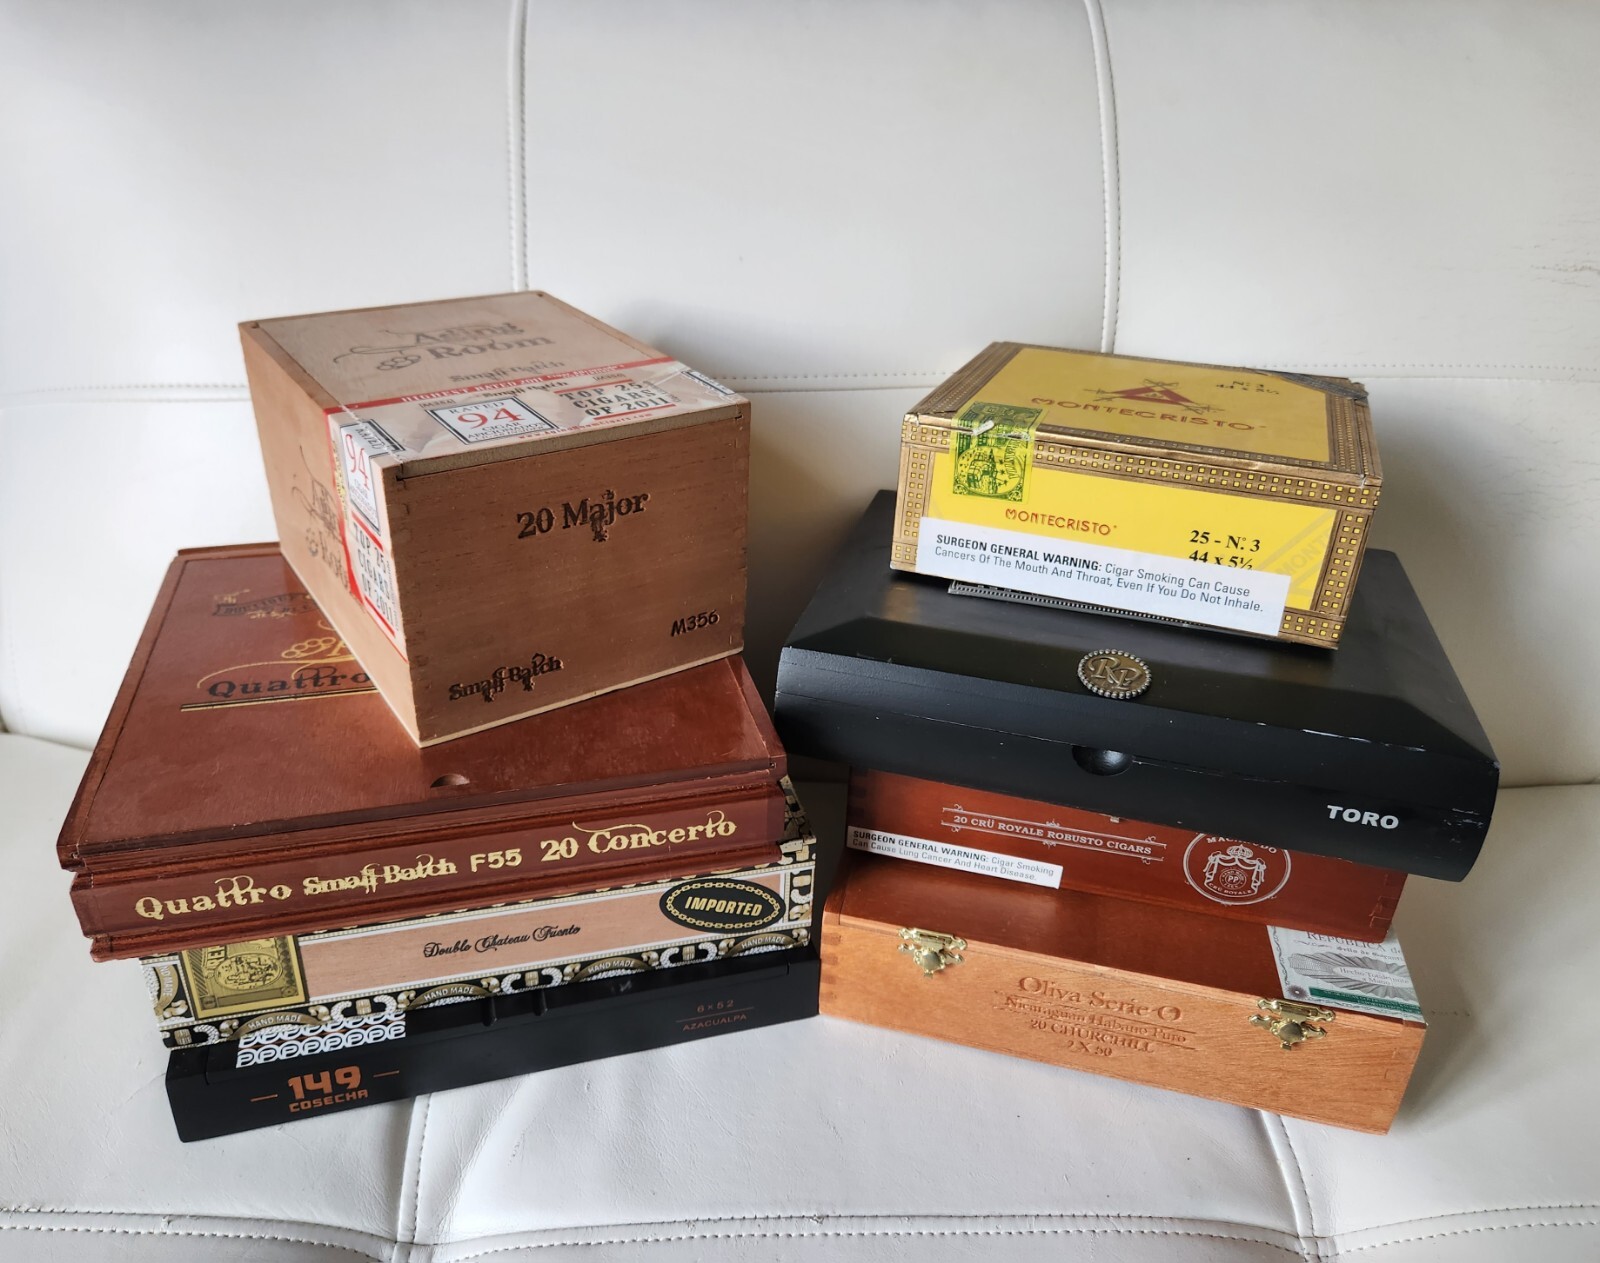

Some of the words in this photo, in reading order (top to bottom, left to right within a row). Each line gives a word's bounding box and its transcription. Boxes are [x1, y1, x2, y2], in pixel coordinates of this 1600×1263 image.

[425, 335, 556, 360] Room
[400, 388, 468, 402] HIGHEST
[475, 381, 516, 392] RATED
[520, 377, 543, 386] 2011
[559, 388, 605, 401] TOP
[615, 383, 644, 392] 25
[572, 388, 659, 409] CIGARS
[448, 402, 505, 414] RATED
[457, 407, 526, 429] 94
[584, 404, 617, 417] OF
[625, 397, 670, 411] 2011
[1030, 396, 1256, 432] MONTECRISTO
[482, 422, 522, 431] CIGAR
[345, 434, 371, 491] 94
[516, 508, 556, 539] 20
[561, 489, 651, 542] Major
[1005, 508, 1112, 537] MONTECRISTO
[1189, 529, 1211, 545] 25
[1250, 538, 1261, 553] 3
[936, 534, 988, 552] SURGEON
[990, 544, 1040, 561] GENERAL
[1043, 552, 1102, 572] WARNING:
[1105, 563, 1134, 578] Cigar
[1136, 568, 1185, 588] Smoking
[1188, 577, 1211, 590] Can
[1214, 581, 1250, 597] Cause
[935, 546, 976, 563] Cancers
[979, 553, 991, 564] Of
[993, 556, 1012, 568] The
[1015, 560, 1049, 575] Mouth
[1051, 566, 1073, 579] And
[1076, 571, 1113, 588] Throat,
[1117, 577, 1143, 592] Even
[1147, 581, 1157, 593] If
[1158, 584, 1178, 598] You
[1180, 588, 1197, 601] Do
[1200, 592, 1221, 605] Not
[1224, 596, 1264, 613] Inhale.
[670, 610, 720, 637] M356
[207, 666, 370, 699] Quattro
[1327, 804, 1399, 830] TORO
[953, 815, 969, 825] 20
[998, 821, 1044, 839] ROYALE
[1047, 830, 1105, 848] ROBUSTO
[1106, 839, 1153, 856] CIGARS
[135, 875, 293, 921] Quattro
[302, 863, 382, 895] Small
[382, 853, 458, 885] Batch
[470, 847, 523, 873] F55
[540, 837, 579, 863] 20
[572, 810, 738, 853] Concerto
[852, 838, 870, 849] Can
[870, 841, 898, 854] Cause
[899, 846, 920, 861] Lung
[921, 850, 953, 865] Cancer
[954, 855, 973, 867] And
[974, 858, 999, 873] Heart
[1000, 863, 1038, 882] Disease.
[853, 830, 896, 846] SURGEON
[898, 838, 939, 854] GENERAL
[941, 846, 989, 863] WARNING:
[991, 855, 1016, 870] Cigar
[1017, 860, 1055, 878] Smoking
[684, 896, 763, 918] IMPORTED
[423, 939, 472, 958] Double
[474, 934, 531, 954] Chateau
[532, 925, 581, 942] Fuente
[741, 938, 763, 950] HAND
[764, 936, 786, 945] MADE
[588, 962, 611, 974] HAND
[612, 959, 635, 968] MADE
[424, 988, 449, 1001] HAND
[450, 986, 475, 995] MADE
[1018, 976, 1081, 1003] Oliva
[1090, 991, 1150, 1017] Serie
[1156, 1005, 1181, 1022] O
[248, 1016, 275, 1030] HAND
[276, 1014, 302, 1023] MADE
[683, 1013, 748, 1031] AZACUALPA
[1031, 1018, 1047, 1030] 20
[1050, 1022, 1154, 1053] CHURCHILL
[1151, 1027, 1187, 1043] Puro
[288, 1065, 362, 1100] 149
[288, 1089, 369, 1113] COSECHA
